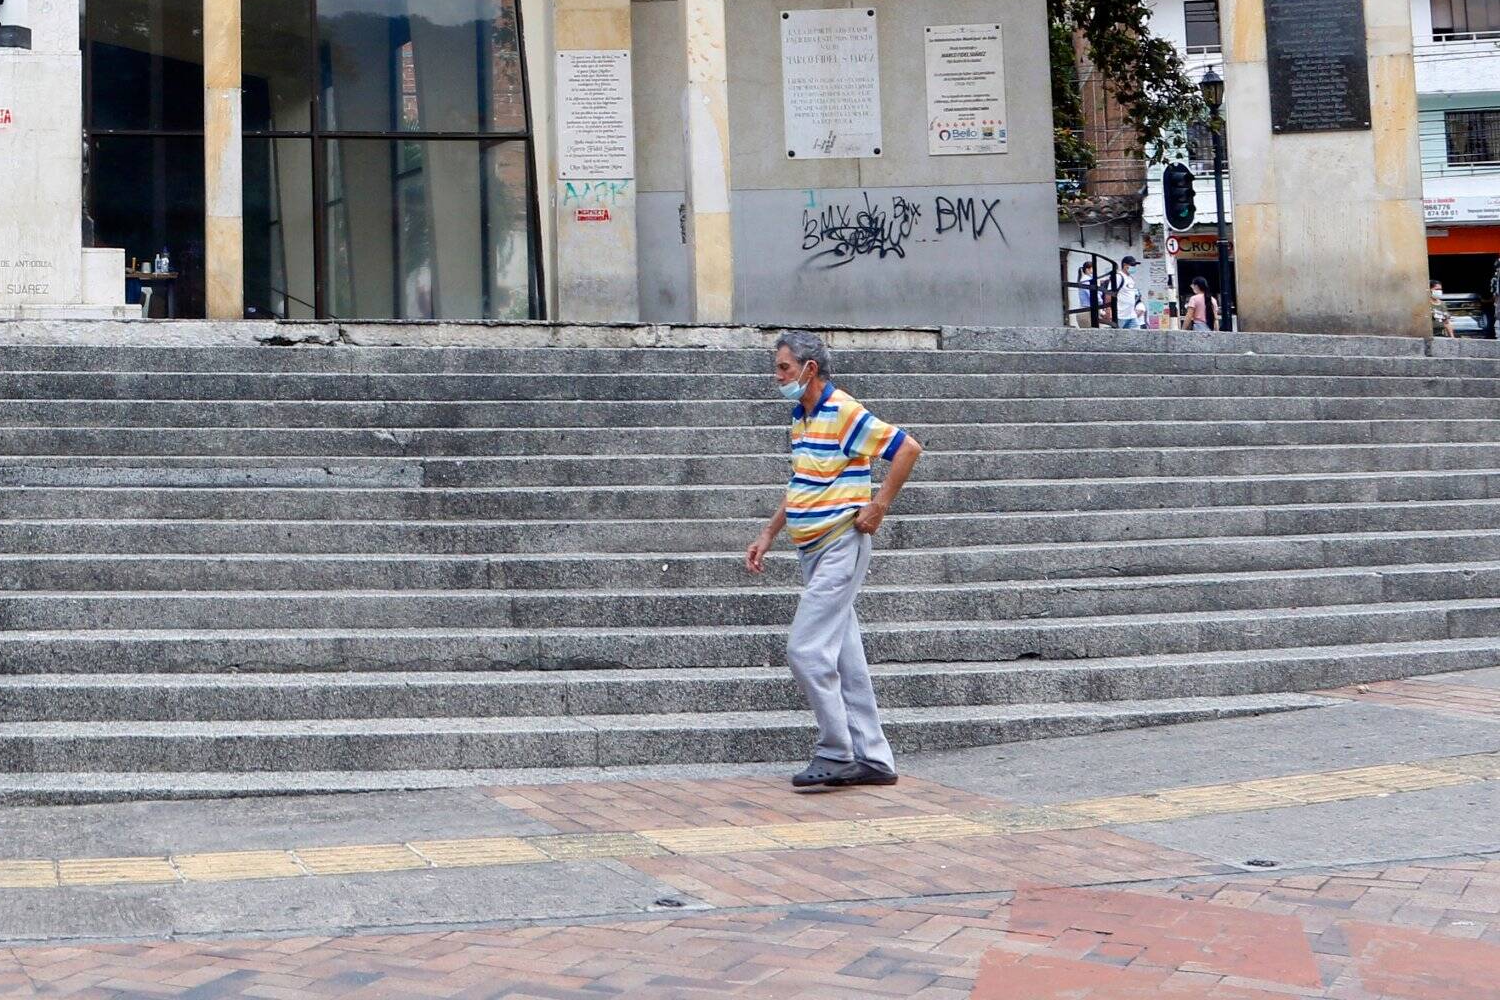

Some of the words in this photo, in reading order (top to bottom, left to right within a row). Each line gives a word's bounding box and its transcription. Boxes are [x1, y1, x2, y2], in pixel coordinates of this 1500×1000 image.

[952, 128, 978, 138] Bello
[935, 195, 1010, 249] BMX
[0, 260, 10, 268] DE
